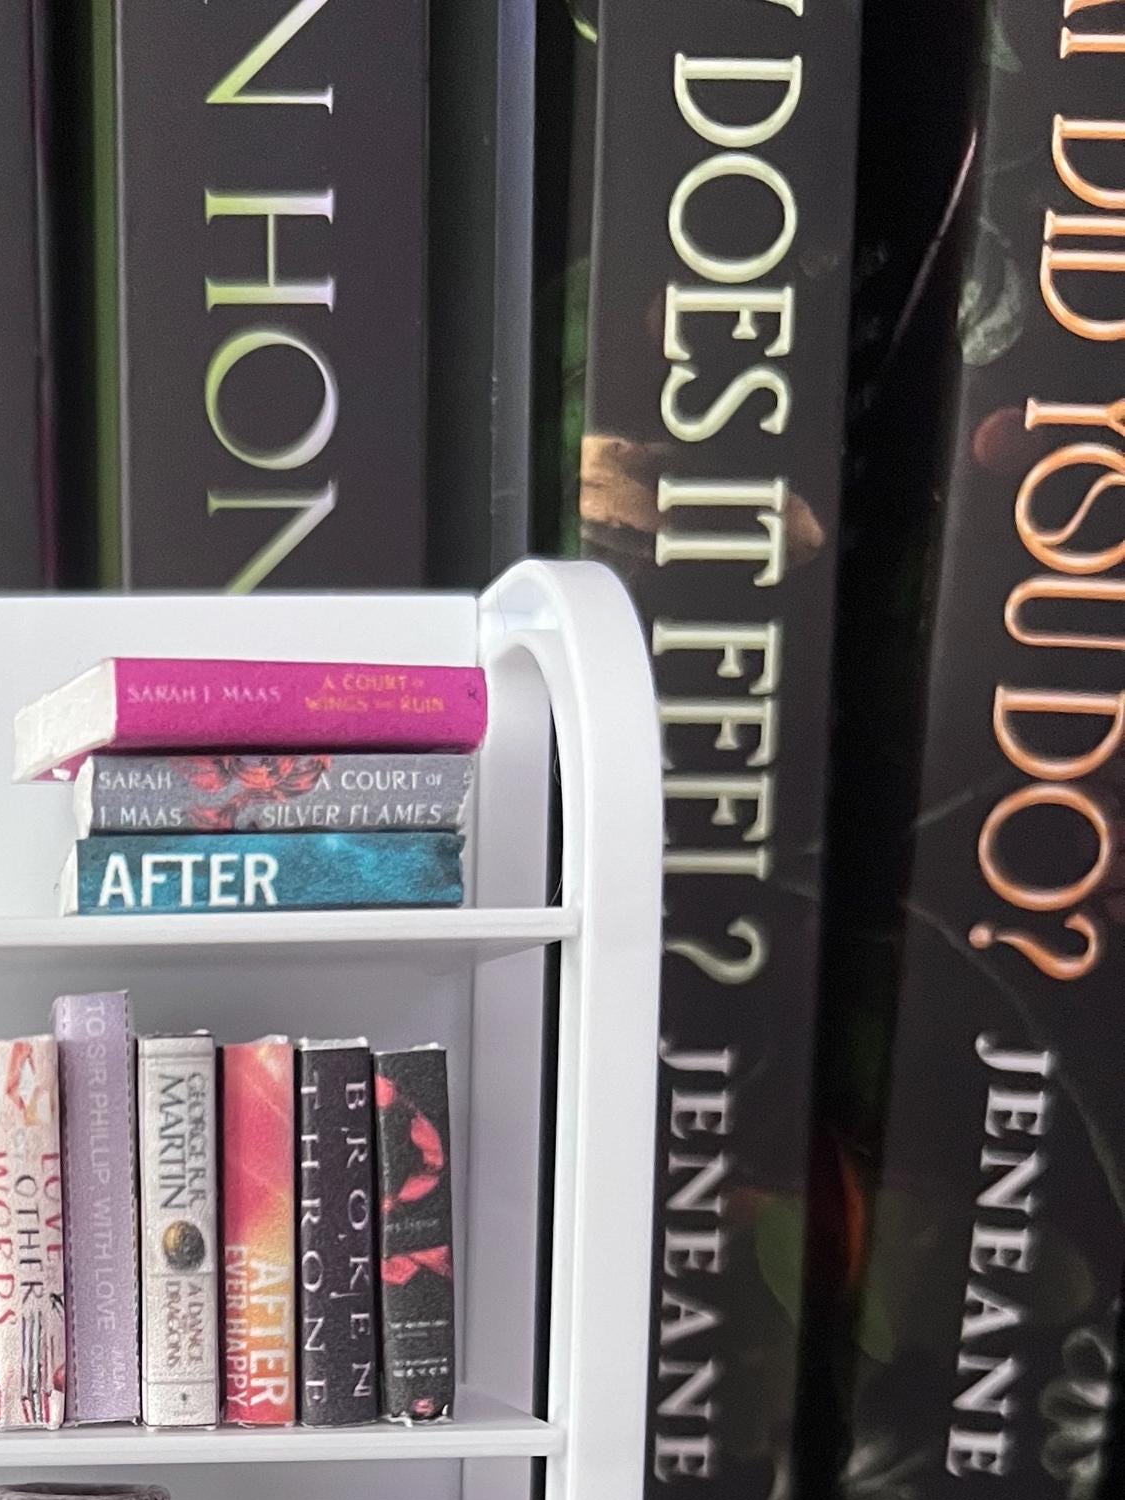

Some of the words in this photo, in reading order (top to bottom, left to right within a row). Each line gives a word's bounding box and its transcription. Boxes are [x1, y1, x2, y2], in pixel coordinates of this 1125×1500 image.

[660, 53, 803, 442] DOES
[655, 480, 787, 587] IT
[127, 684, 197, 704] SARAH
[222, 685, 281, 704] MAAS
[342, 673, 407, 692] COURT
[98, 770, 173, 791] SARAH
[340, 770, 421, 791] COURT
[120, 806, 183, 827] MAAS
[260, 804, 341, 828] SILVER
[348, 803, 444, 827] FLAMES
[968, 685, 1125, 981] DO?
[96, 852, 280, 908] AFTER
[84, 1002, 106, 1036] TO
[88, 1044, 107, 1085] SIR
[158, 1073, 187, 1210] MARTIN
[16, 1175, 43, 1303] OTHER
[92, 1195, 114, 1260] WITH
[300, 1072, 328, 1405] THRONE
[344, 1081, 372, 1398] BROKEN
[653, 1036, 736, 1483] JENEANE
[945, 1032, 1057, 1478] JENEANE
[94, 1269, 116, 1330] LOVE
[224, 1245, 247, 1311] EVER
[225, 1318, 248, 1406] HAPPY
[247, 1259, 291, 1406] AFTER
